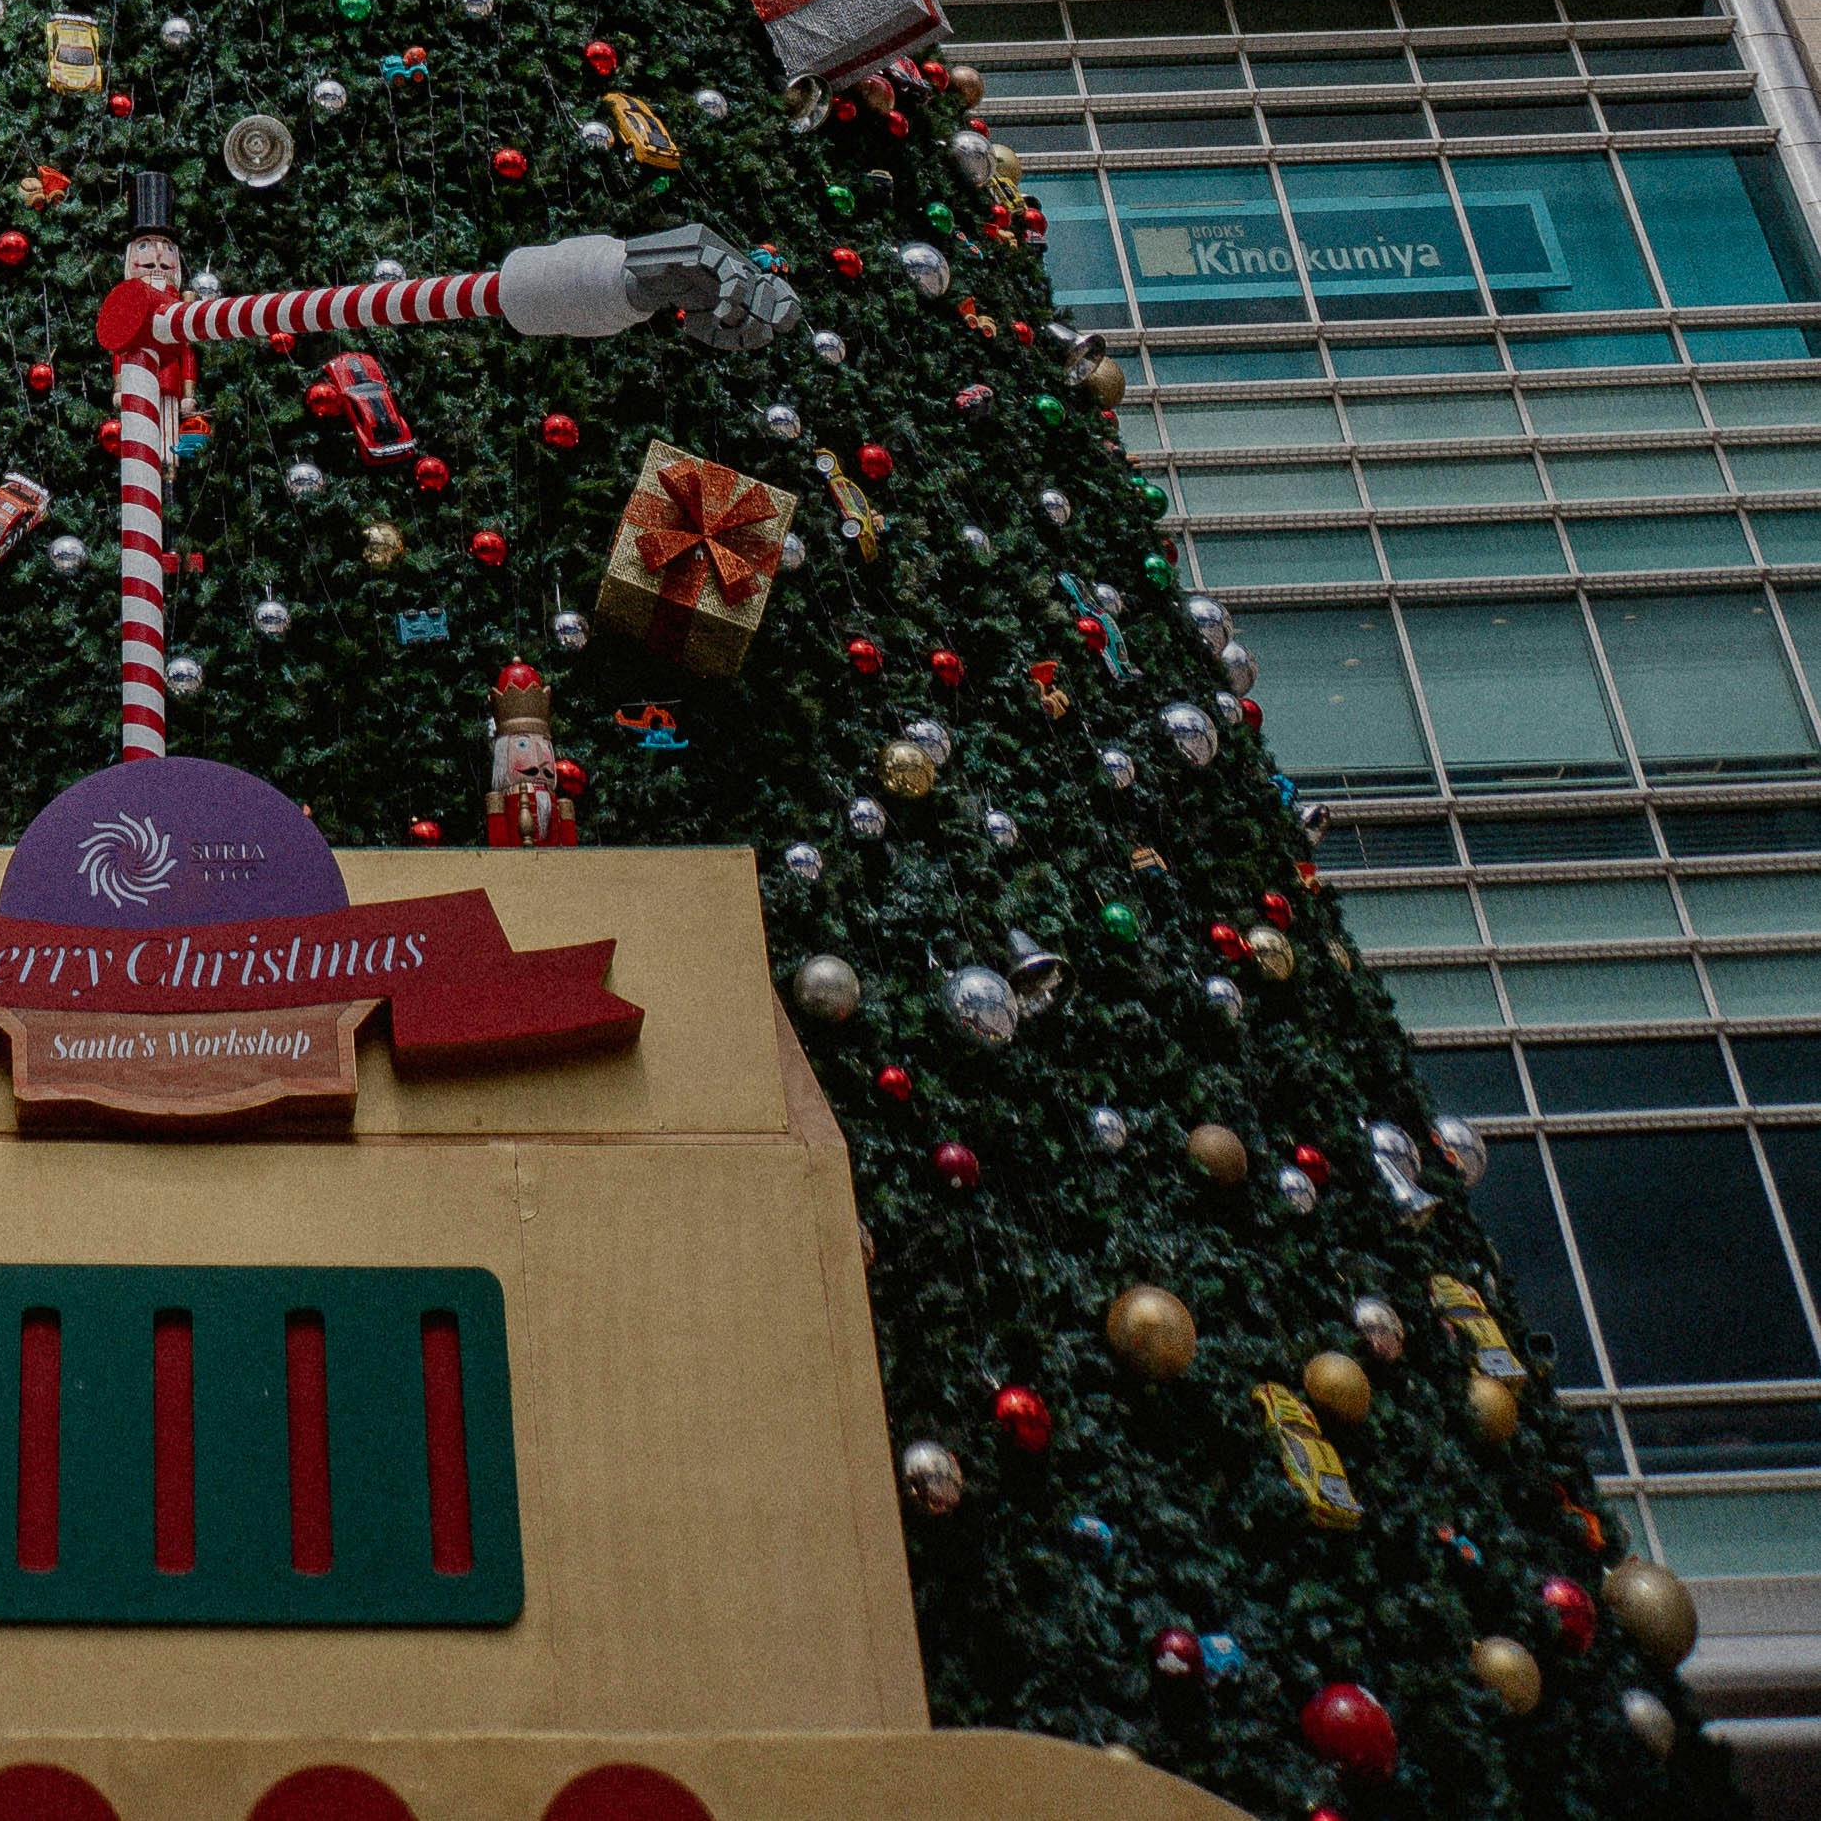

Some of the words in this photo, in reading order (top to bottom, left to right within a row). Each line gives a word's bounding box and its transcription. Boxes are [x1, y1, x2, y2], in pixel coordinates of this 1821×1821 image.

[1191, 225, 1245, 239] BOOKS
[1195, 235, 1442, 278] Kinokuniya
[190, 843, 266, 860] SURIA
[126, 931, 427, 989] Christmas
[167, 1027, 312, 1061] Workshop
